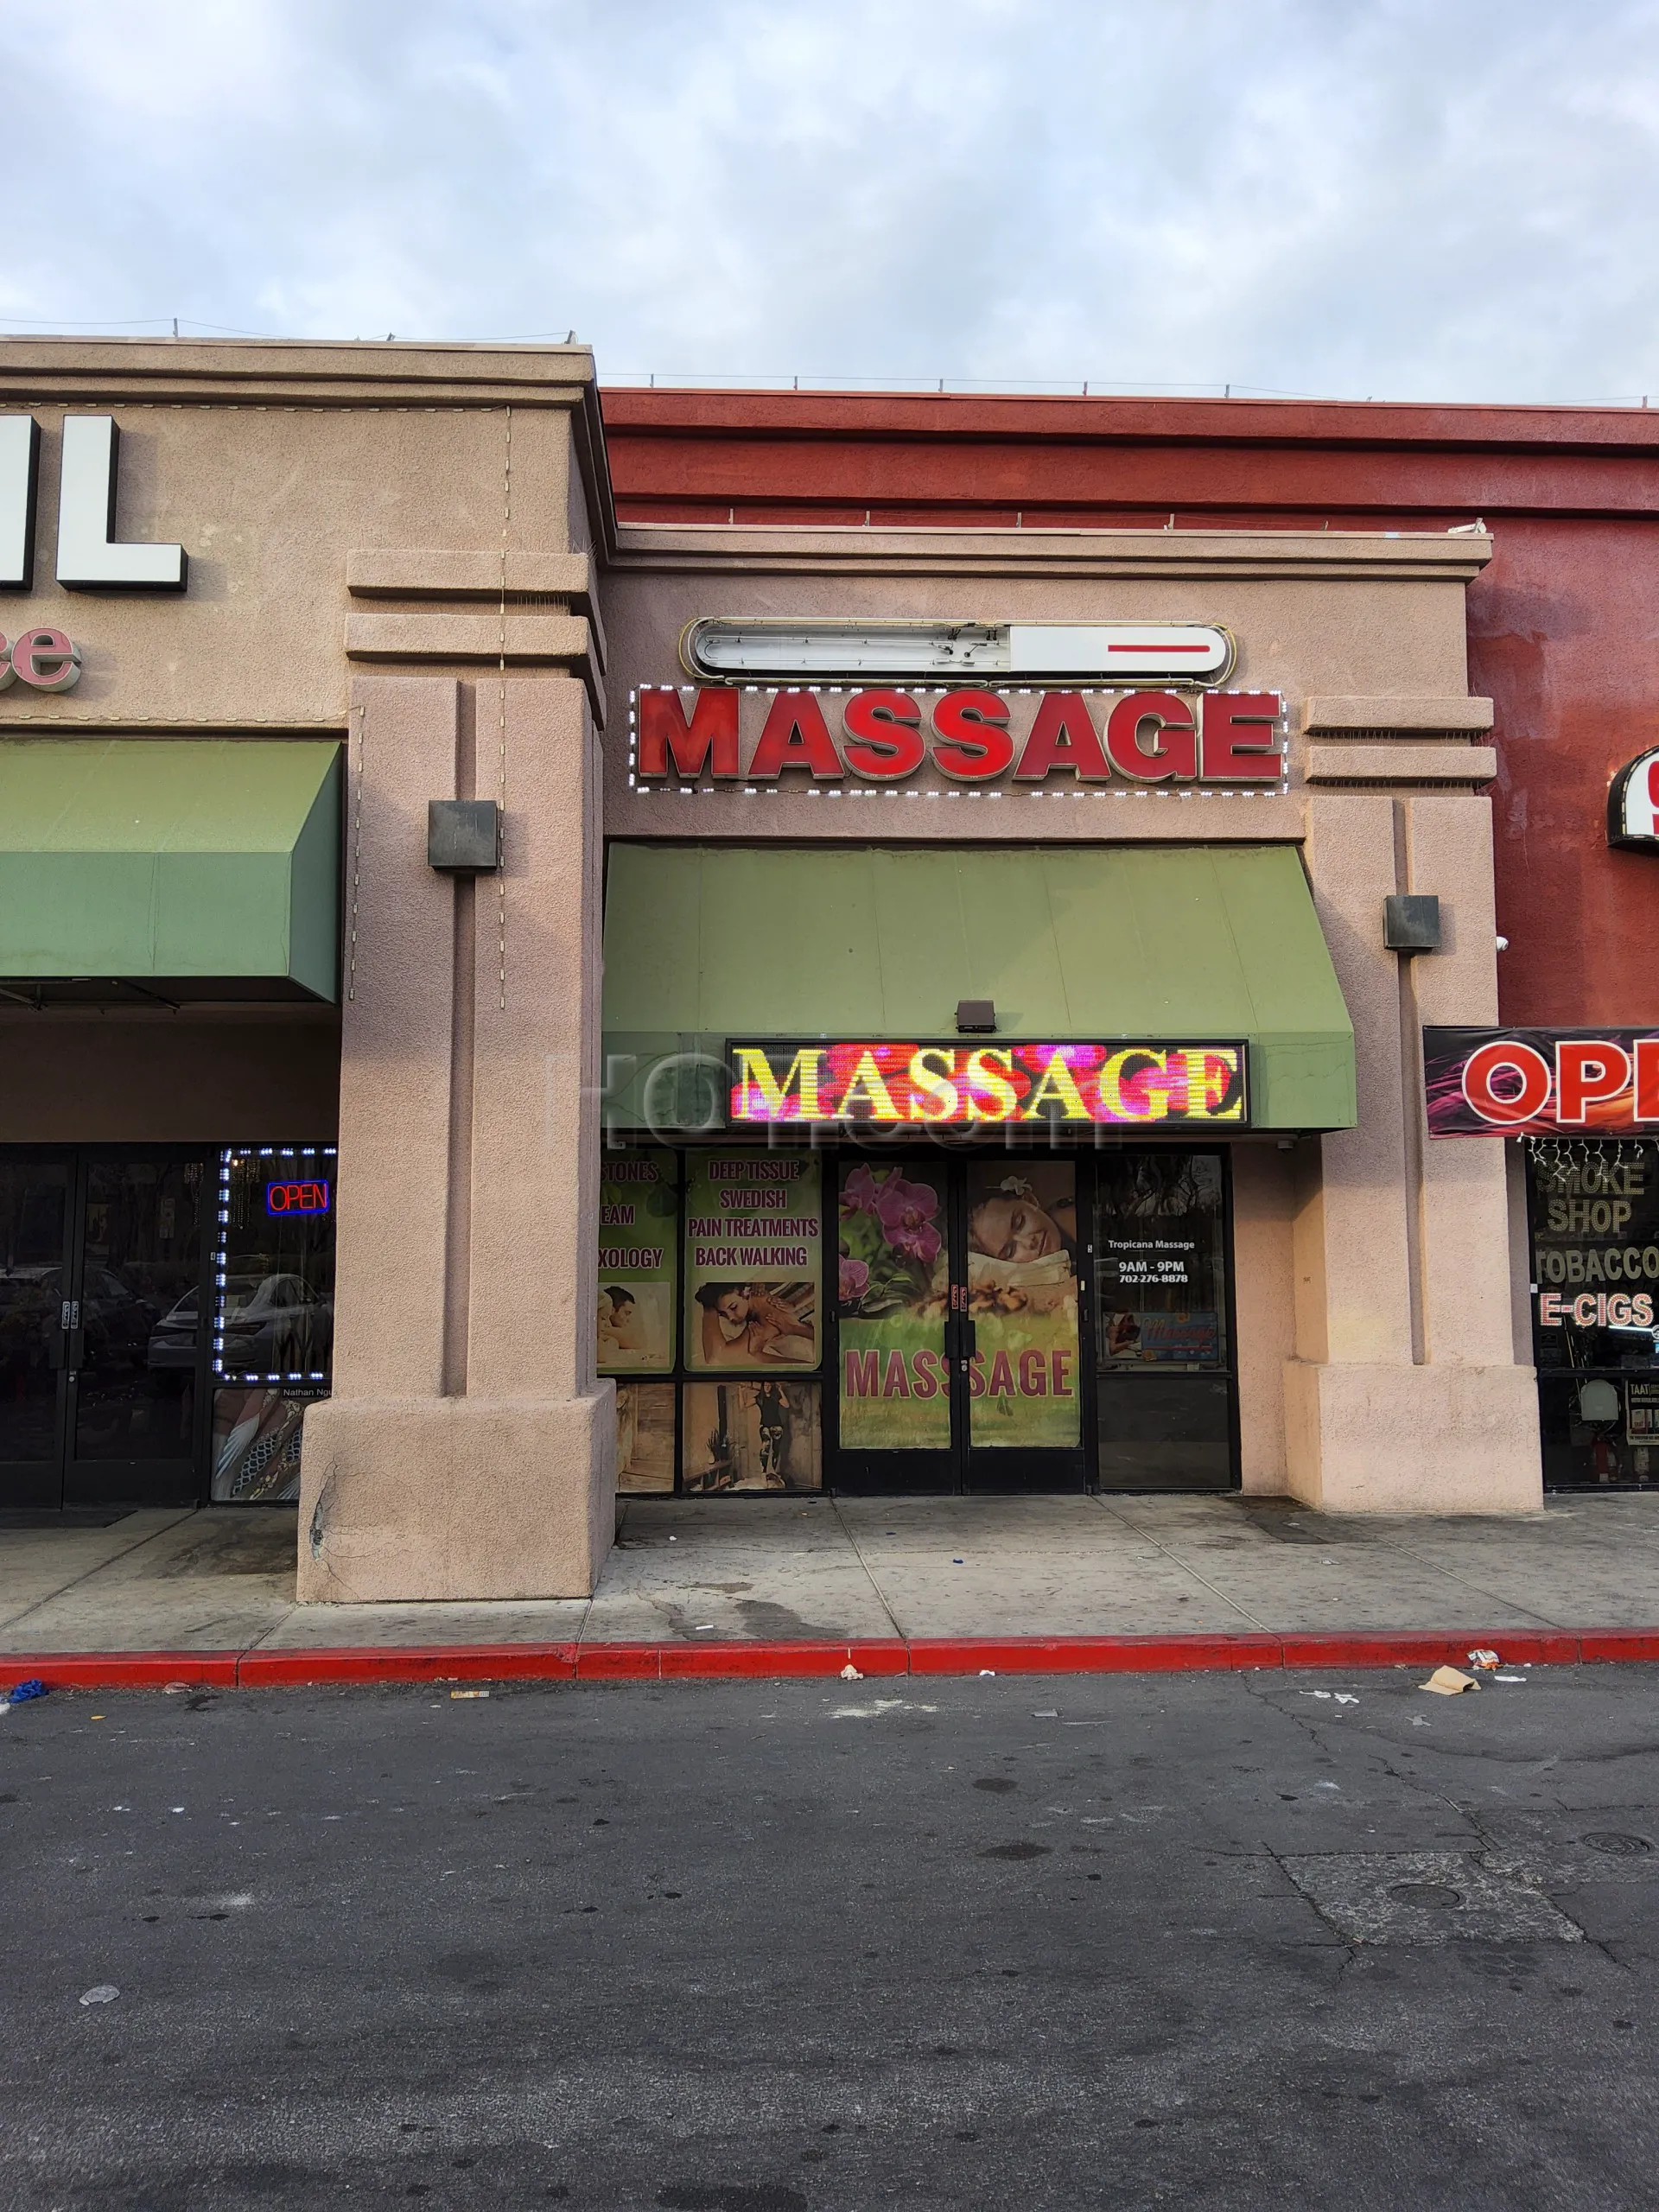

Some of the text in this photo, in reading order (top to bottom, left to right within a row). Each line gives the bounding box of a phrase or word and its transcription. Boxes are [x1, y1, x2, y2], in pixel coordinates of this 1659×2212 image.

[638, 687, 1287, 783] MASSAGE
[731, 1047, 1242, 1122] MASSAGE
[709, 1160, 800, 1181] DEEP TISSUE
[1536, 1161, 1645, 1195] SMOKE
[270, 1183, 327, 1211] OPEN
[719, 1189, 787, 1210] SWEDISH
[688, 1217, 819, 1238] PAIN TREATMENTS
[1547, 1198, 1632, 1234] SHOP
[695, 1247, 808, 1267] BACK WALKING
[1108, 1239, 1195, 1251] Tropicana Massage
[1118, 1261, 1147, 1273] 9AM
[1156, 1261, 1185, 1273] 9PM
[1535, 1246, 1659, 1285] TOBACCO
[1119, 1274, 1188, 1283] 702-276-8878
[1539, 1293, 1654, 1327] E-CIGS
[844, 1349, 1074, 1399] MASSAGE
[1630, 1383, 1649, 1395] TAAT
